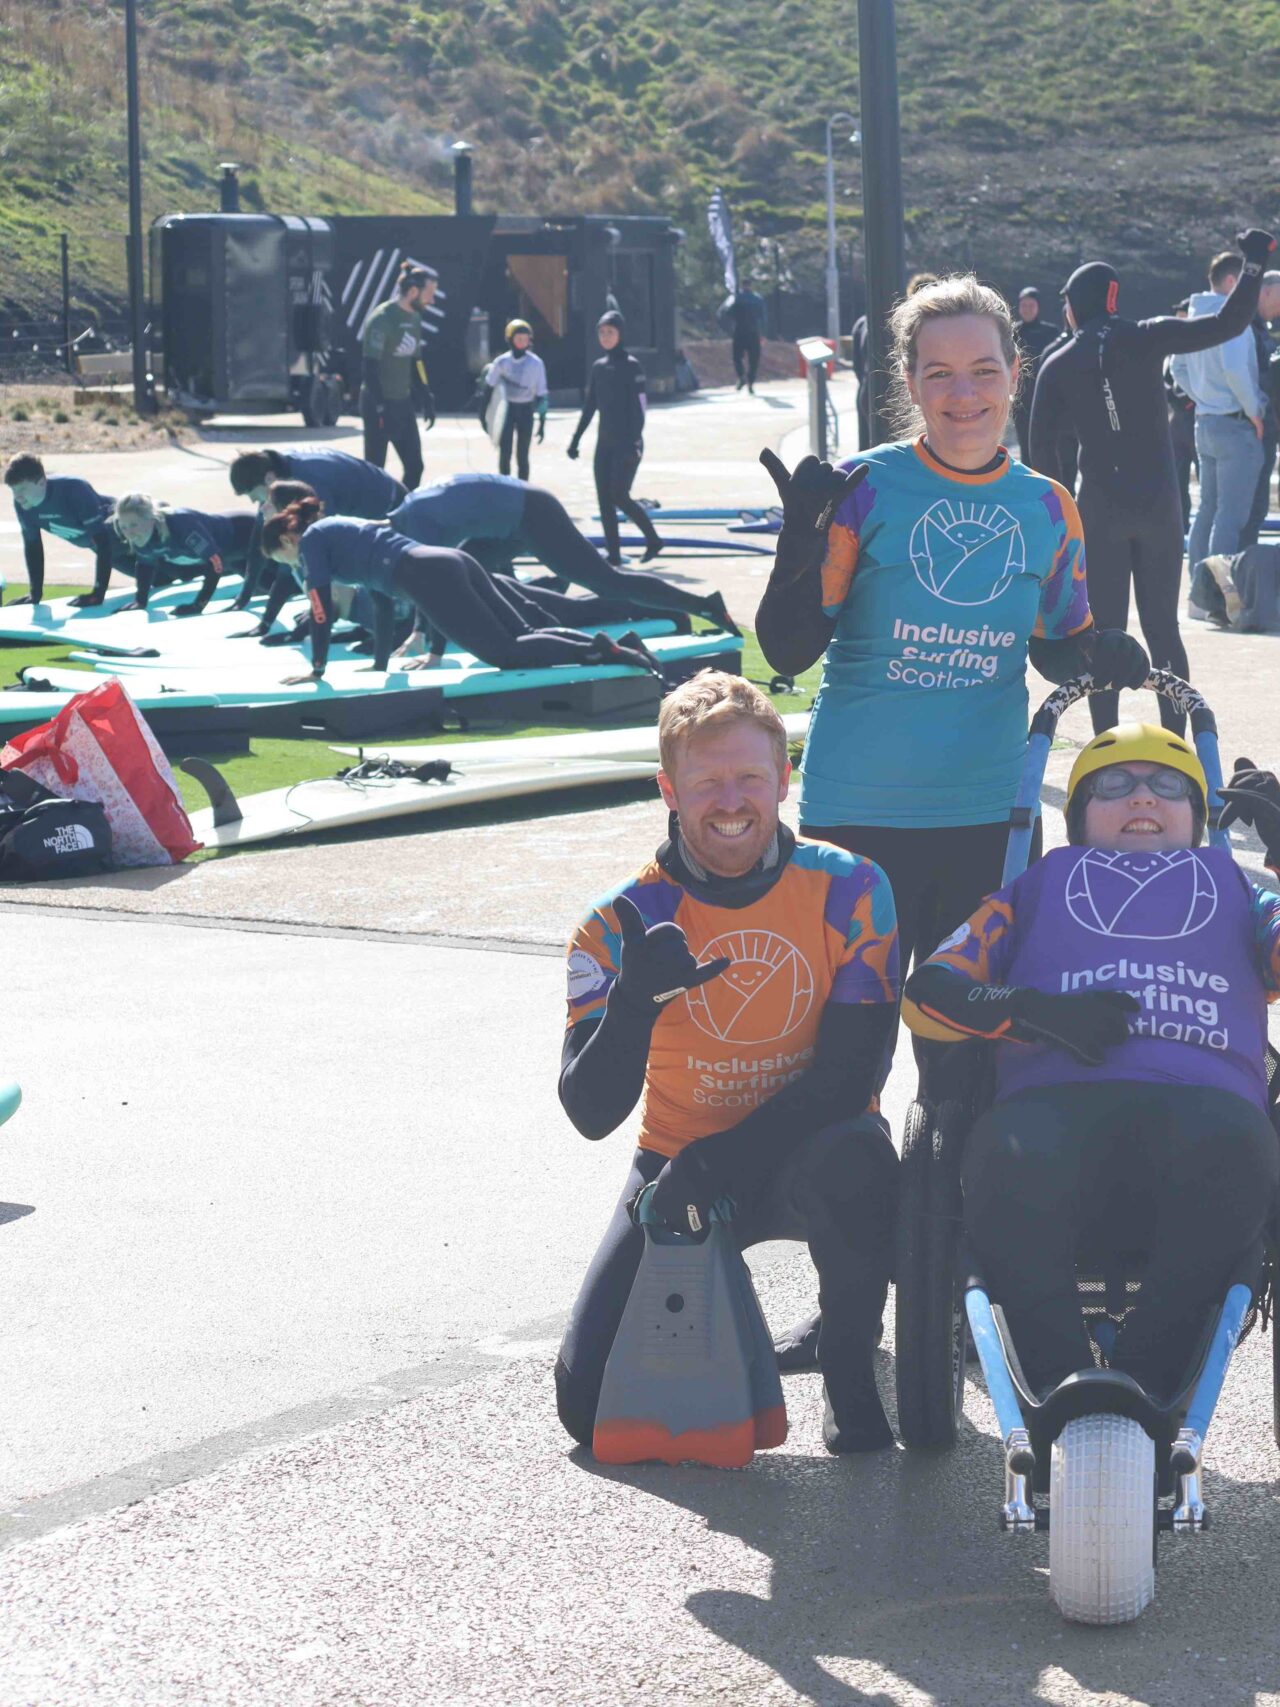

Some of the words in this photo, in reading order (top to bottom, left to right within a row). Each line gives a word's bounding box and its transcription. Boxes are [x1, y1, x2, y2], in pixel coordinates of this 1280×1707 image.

[893, 618, 1016, 647] Inclusive
[886, 659, 999, 689] Scotla
[43, 833, 77, 848] NORTH
[54, 825, 74, 836] THE
[55, 841, 79, 854] FACE
[1061, 959, 1230, 993] Inclusive
[968, 987, 1017, 1002] HALO
[1117, 984, 1219, 1026] fing
[1126, 1015, 1229, 1050] tland
[687, 1046, 814, 1074] Inclusive
[692, 1088, 776, 1107] Scotl
